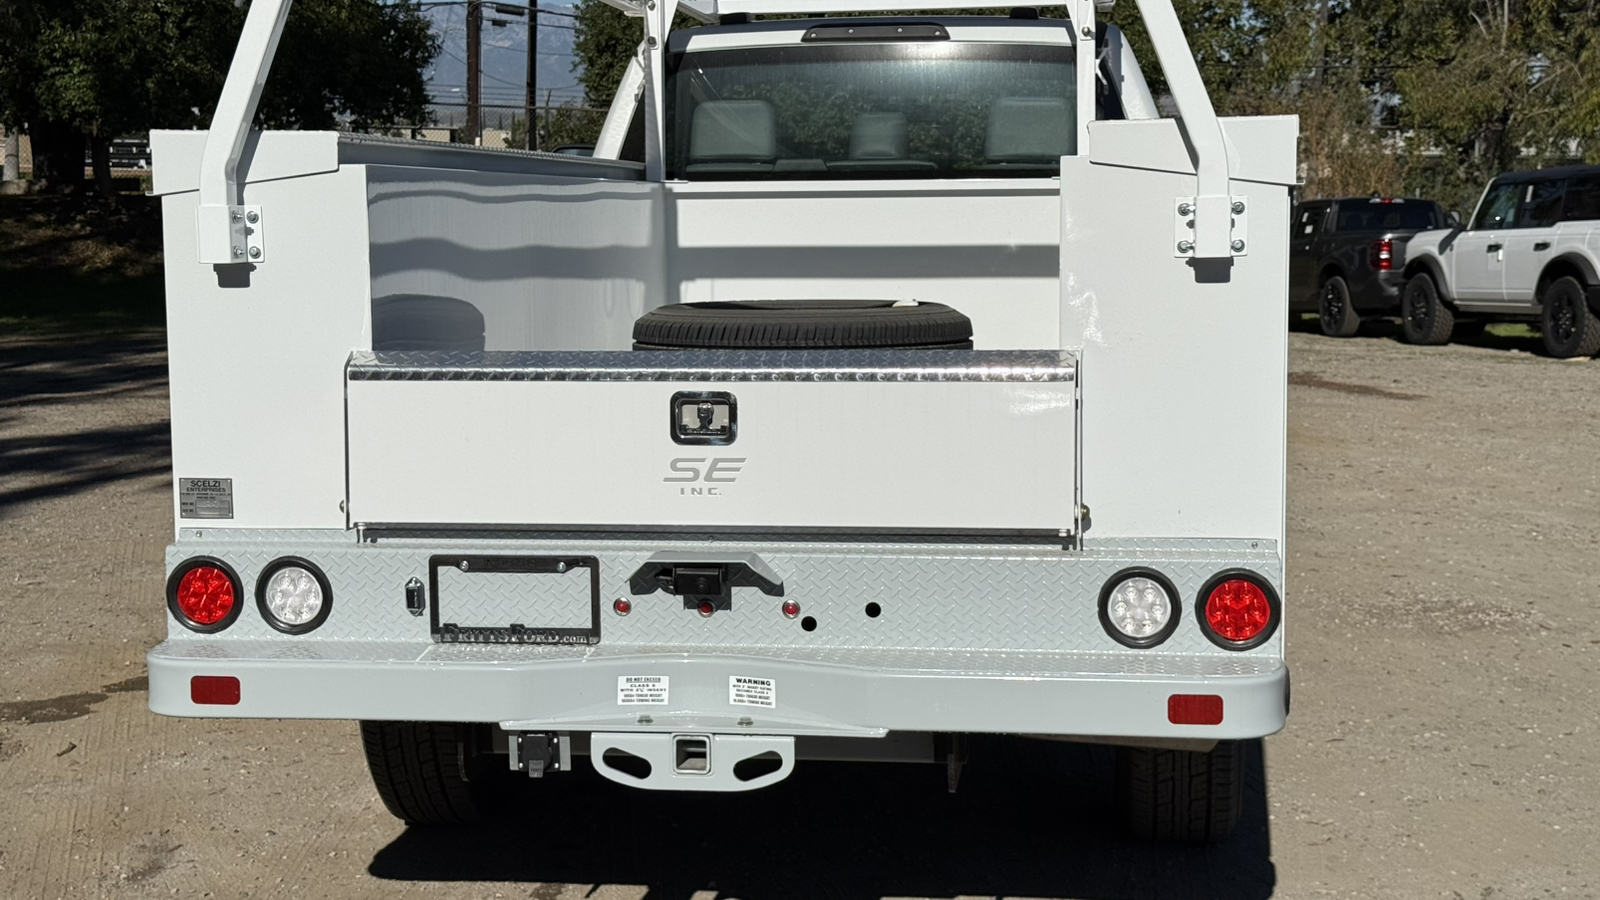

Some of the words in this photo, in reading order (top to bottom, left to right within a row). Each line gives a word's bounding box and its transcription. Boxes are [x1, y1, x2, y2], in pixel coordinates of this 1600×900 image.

[662, 457, 748, 482] SE
[190, 480, 221, 488] SCELZI
[680, 487, 722, 496] INC.
[735, 677, 771, 687] WARNING
